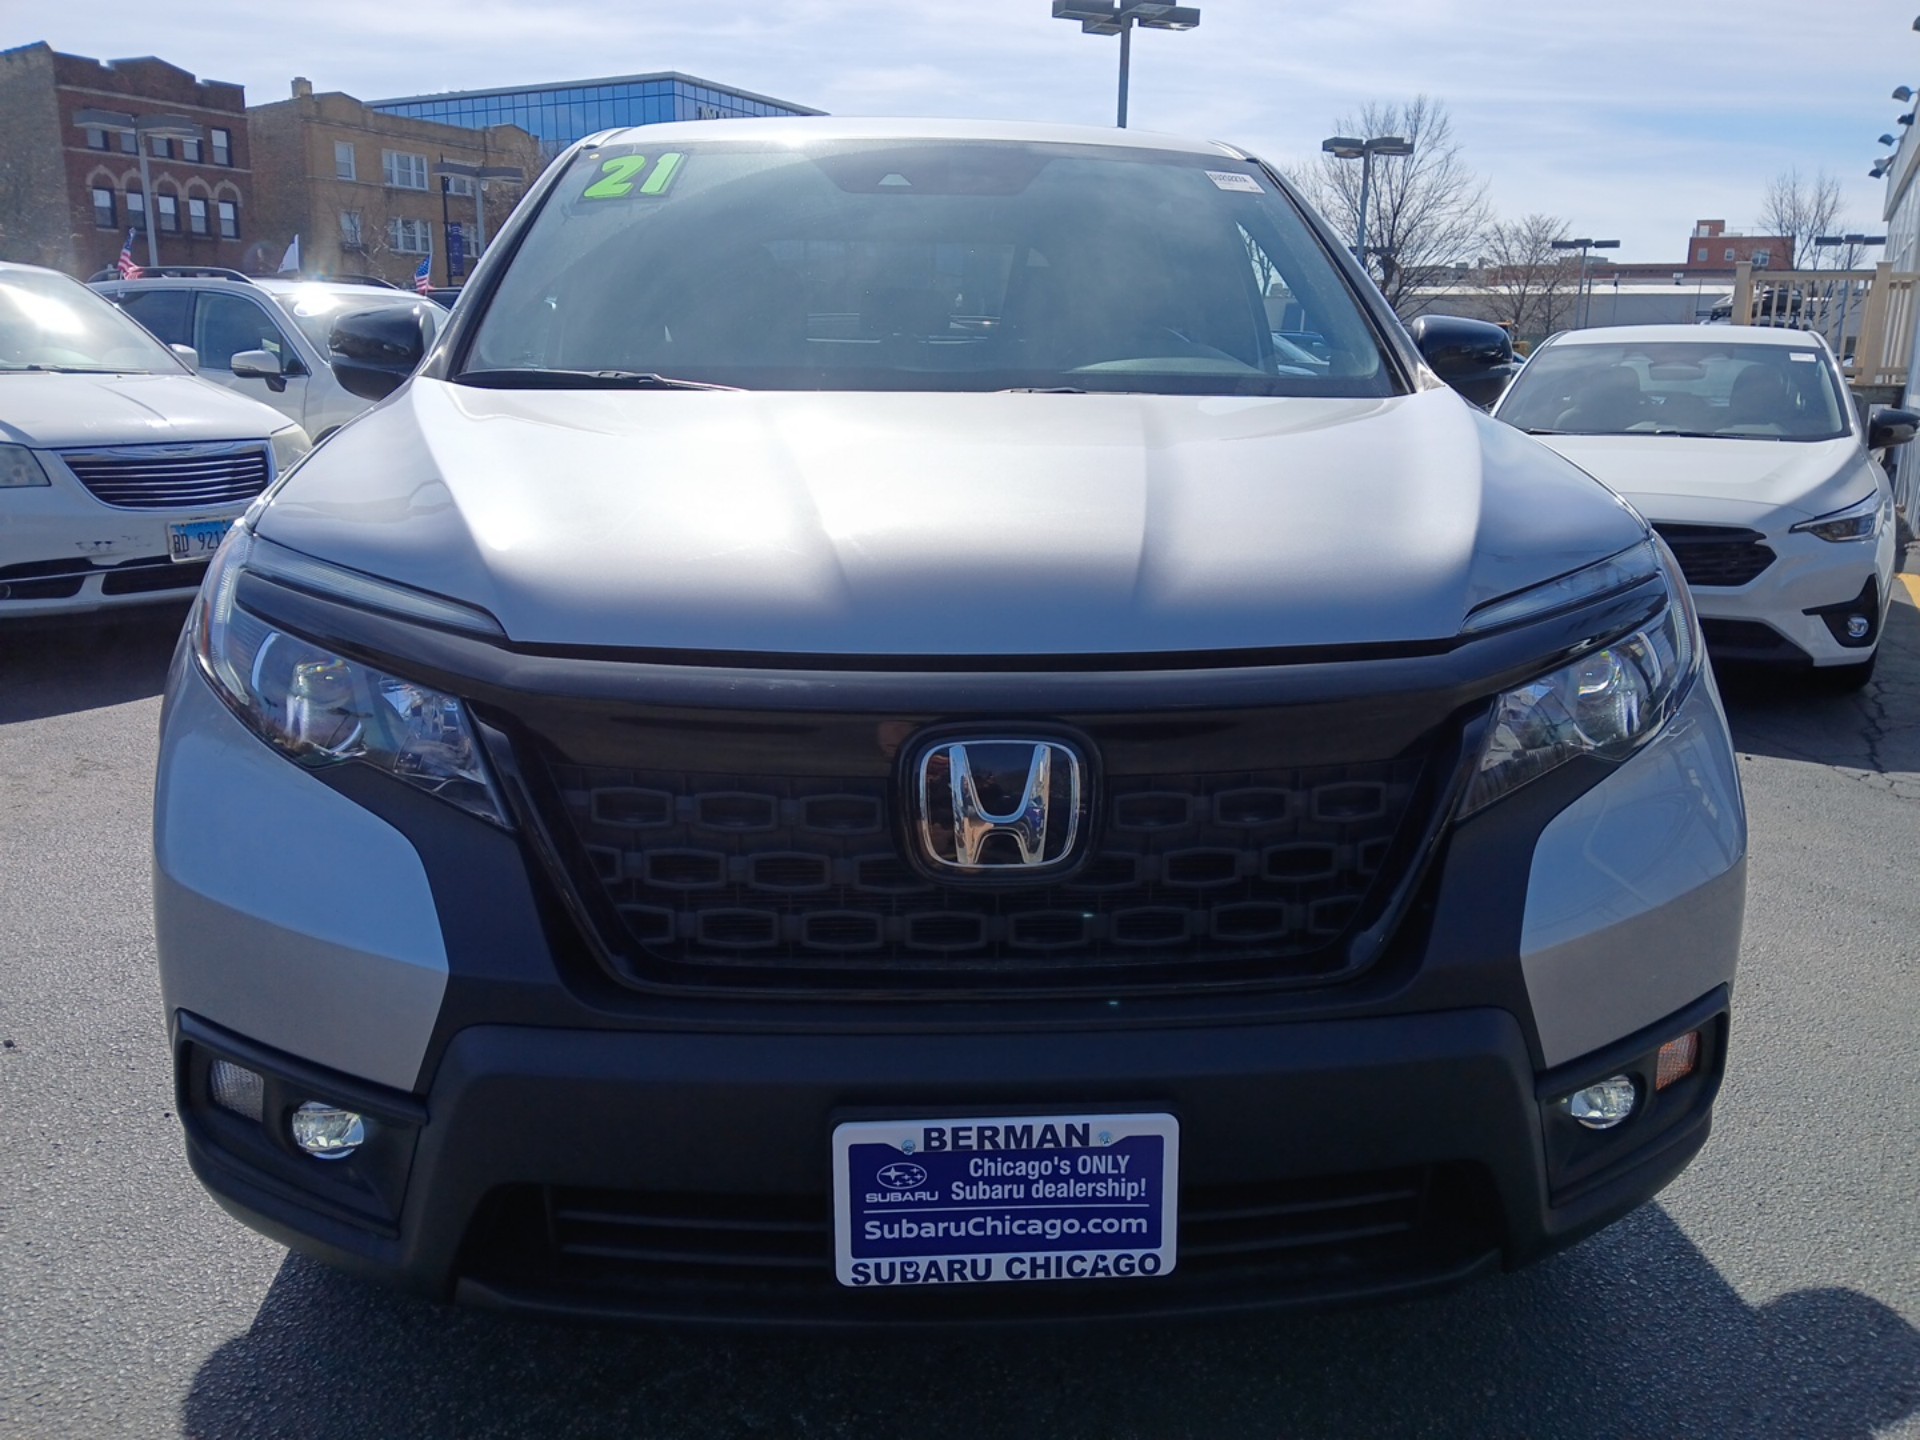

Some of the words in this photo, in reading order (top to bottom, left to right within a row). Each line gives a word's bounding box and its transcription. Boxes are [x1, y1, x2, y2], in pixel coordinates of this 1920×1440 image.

[584, 152, 685, 199] 21
[173, 533, 189, 553] BD
[197, 530, 226, 551] 921
[923, 1123, 1090, 1151] BERMAN
[969, 1156, 1071, 1180] Chicago's
[1077, 1155, 1130, 1175] ONLY
[865, 1190, 939, 1203] SUBARU
[951, 1180, 1025, 1201] Subaru
[1032, 1178, 1146, 1200] dealership!
[864, 1215, 1148, 1240] SubaruChicago.com
[851, 1257, 993, 1286] SUBARU
[1005, 1252, 1161, 1280] CHICAGO
